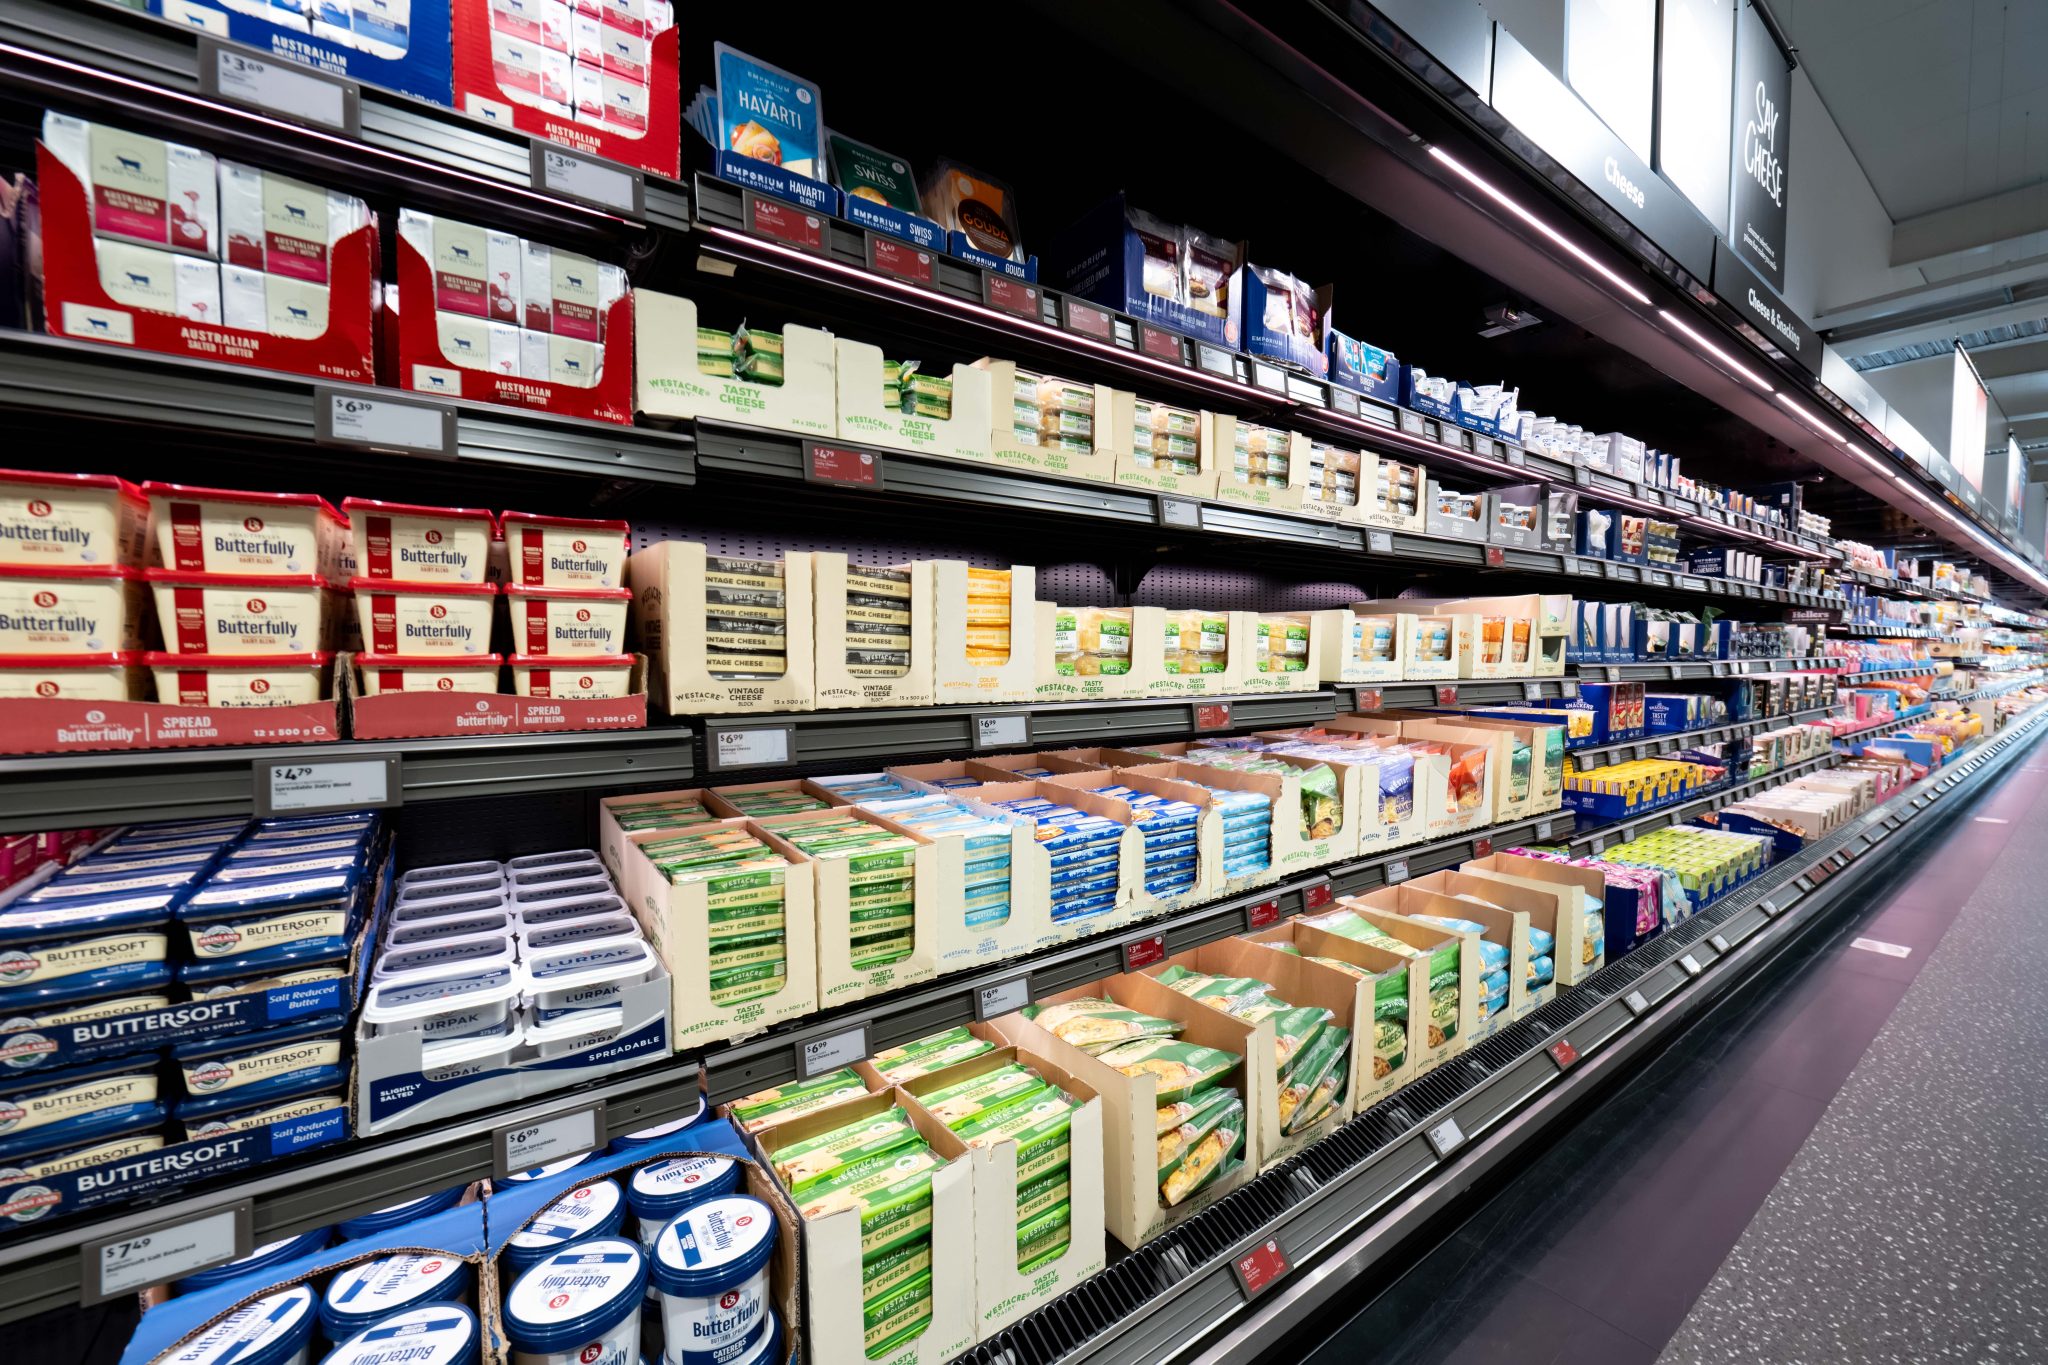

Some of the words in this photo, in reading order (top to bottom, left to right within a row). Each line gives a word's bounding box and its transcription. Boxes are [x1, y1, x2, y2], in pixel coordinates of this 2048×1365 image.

[272, 34, 347, 67] AUSTRALIAN
[739, 90, 801, 130] HAVARTI
[545, 122, 601, 147] AUSTRALIAN
[726, 164, 783, 189] EMPORIUM
[790, 180, 825, 202] HAVARTI
[854, 164, 896, 190] SWISS
[1604, 156, 1644, 209] Cheese
[104, 189, 159, 210] AUSTRALIAN
[738, 176, 772, 191] SELECTION
[800, 196, 816, 208] SLICES
[854, 208, 901, 230] EMPORIUM
[910, 223, 932, 240] SWISS
[963, 213, 1008, 241] GOUDA
[274, 236, 320, 253] AUSTRALIAN
[963, 252, 996, 267] EMPORIUM
[1006, 263, 1025, 278] GOUDA
[443, 275, 482, 289] AUSTRALIAN
[1749, 288, 1770, 321] Cheese
[1771, 309, 1775, 326] &
[1777, 314, 1800, 351] Snacking
[181, 327, 259, 350] AUSTRALIAN
[495, 381, 551, 397] AUSTRALIAN
[649, 379, 704, 396] WESTACRE
[723, 384, 760, 398] TASTY
[719, 394, 765, 409] CHEESE
[845, 416, 888, 430] WESTACRE
[902, 419, 932, 430] TASTY
[900, 428, 935, 440] CHEESE
[1044, 461, 1068, 470] CHEESE
[1047, 454, 1067, 462] TASTY
[1160, 475, 1177, 483] TASTY
[215, 537, 294, 558] Butterfully
[401, 548, 468, 568] Butterfully
[552, 557, 608, 574] Butterfully
[736, 579, 765, 587] CHEESE
[218, 619, 297, 637] Butterfully
[406, 624, 471, 641] Butterfully
[555, 627, 611, 641] Butterfully
[675, 690, 721, 702] WESTACRE
[728, 687, 764, 695] VINTAGE
[821, 689, 857, 697] WESTACRE
[1035, 684, 1075, 694] WESTACRE
[457, 714, 509, 727] Butterfully
[528, 706, 561, 716] SPREAD
[524, 716, 542, 724] DAIRY
[544, 715, 564, 723] BLEND
[57, 729, 135, 743] Butterfully
[164, 717, 211, 728] SPREAD
[157, 729, 184, 738] DAIRY
[186, 728, 218, 738] BLEND
[278, 728, 300, 736] 500
[870, 873, 894, 881] CHEESE
[729, 893, 758, 902] CHEESE
[868, 897, 891, 905] CHEESE
[247, 917, 331, 935] BUTTERSOFT
[541, 924, 619, 940] LURPAK
[737, 920, 765, 929] CHEESE
[868, 922, 891, 930] CHEESE
[47, 940, 148, 962] BUTTERSOFT
[871, 944, 894, 953] CHEESE
[978, 940, 996, 948] TASTY
[402, 943, 491, 963] LURPAK
[546, 948, 630, 968] LURPAK
[736, 951, 764, 961] CHEESE
[868, 974, 894, 984] CHEESE
[871, 969, 893, 978] TASTY
[269, 995, 290, 1004] Salt
[292, 985, 337, 1000] Reduced
[566, 986, 621, 1003] LURPAK
[734, 985, 762, 996] CHEESE
[827, 982, 861, 995] WESTACRE
[289, 997, 320, 1009] Butter
[736, 1003, 762, 1014] TASTY
[73, 1001, 240, 1043] BUTTERSOFT
[733, 1009, 765, 1021] CHEESE
[681, 1019, 726, 1036] WESTACRE
[589, 1036, 660, 1061] SPREADABLE
[238, 1046, 321, 1071] BUTTERSOFT
[33, 1082, 135, 1111] BUTTERSOFT
[380, 1083, 421, 1097] SLIGHTLY
[380, 1090, 414, 1103] SALTED
[273, 1130, 293, 1139] Salt
[295, 1117, 339, 1135] Reduced
[293, 1130, 323, 1142] Butter
[40, 1144, 143, 1177] BUTTERSOFT
[77, 1138, 245, 1192] BUTTERSOFT
[217, 1158, 249, 1168] SPREAD
[1028, 1152, 1055, 1172] CHEESE
[1024, 1194, 1051, 1213] CHEESE
[866, 1204, 911, 1228] WESTACRE
[707, 1211, 732, 1251] Butterfully
[875, 1219, 910, 1241] CHEESE
[538, 1275, 611, 1288] Butterfully
[877, 1264, 911, 1287] CHEESE
[1034, 1269, 1057, 1285] TASTY
[876, 1290, 920, 1318] WESTACRE
[984, 1294, 1026, 1321] WESTACRE
[1032, 1275, 1059, 1295] CHEESE
[693, 1295, 761, 1337] Butterfully
[885, 1306, 920, 1330] CHEESE
[713, 1337, 746, 1359] CATERERS
[717, 1347, 744, 1363] SELECTION
